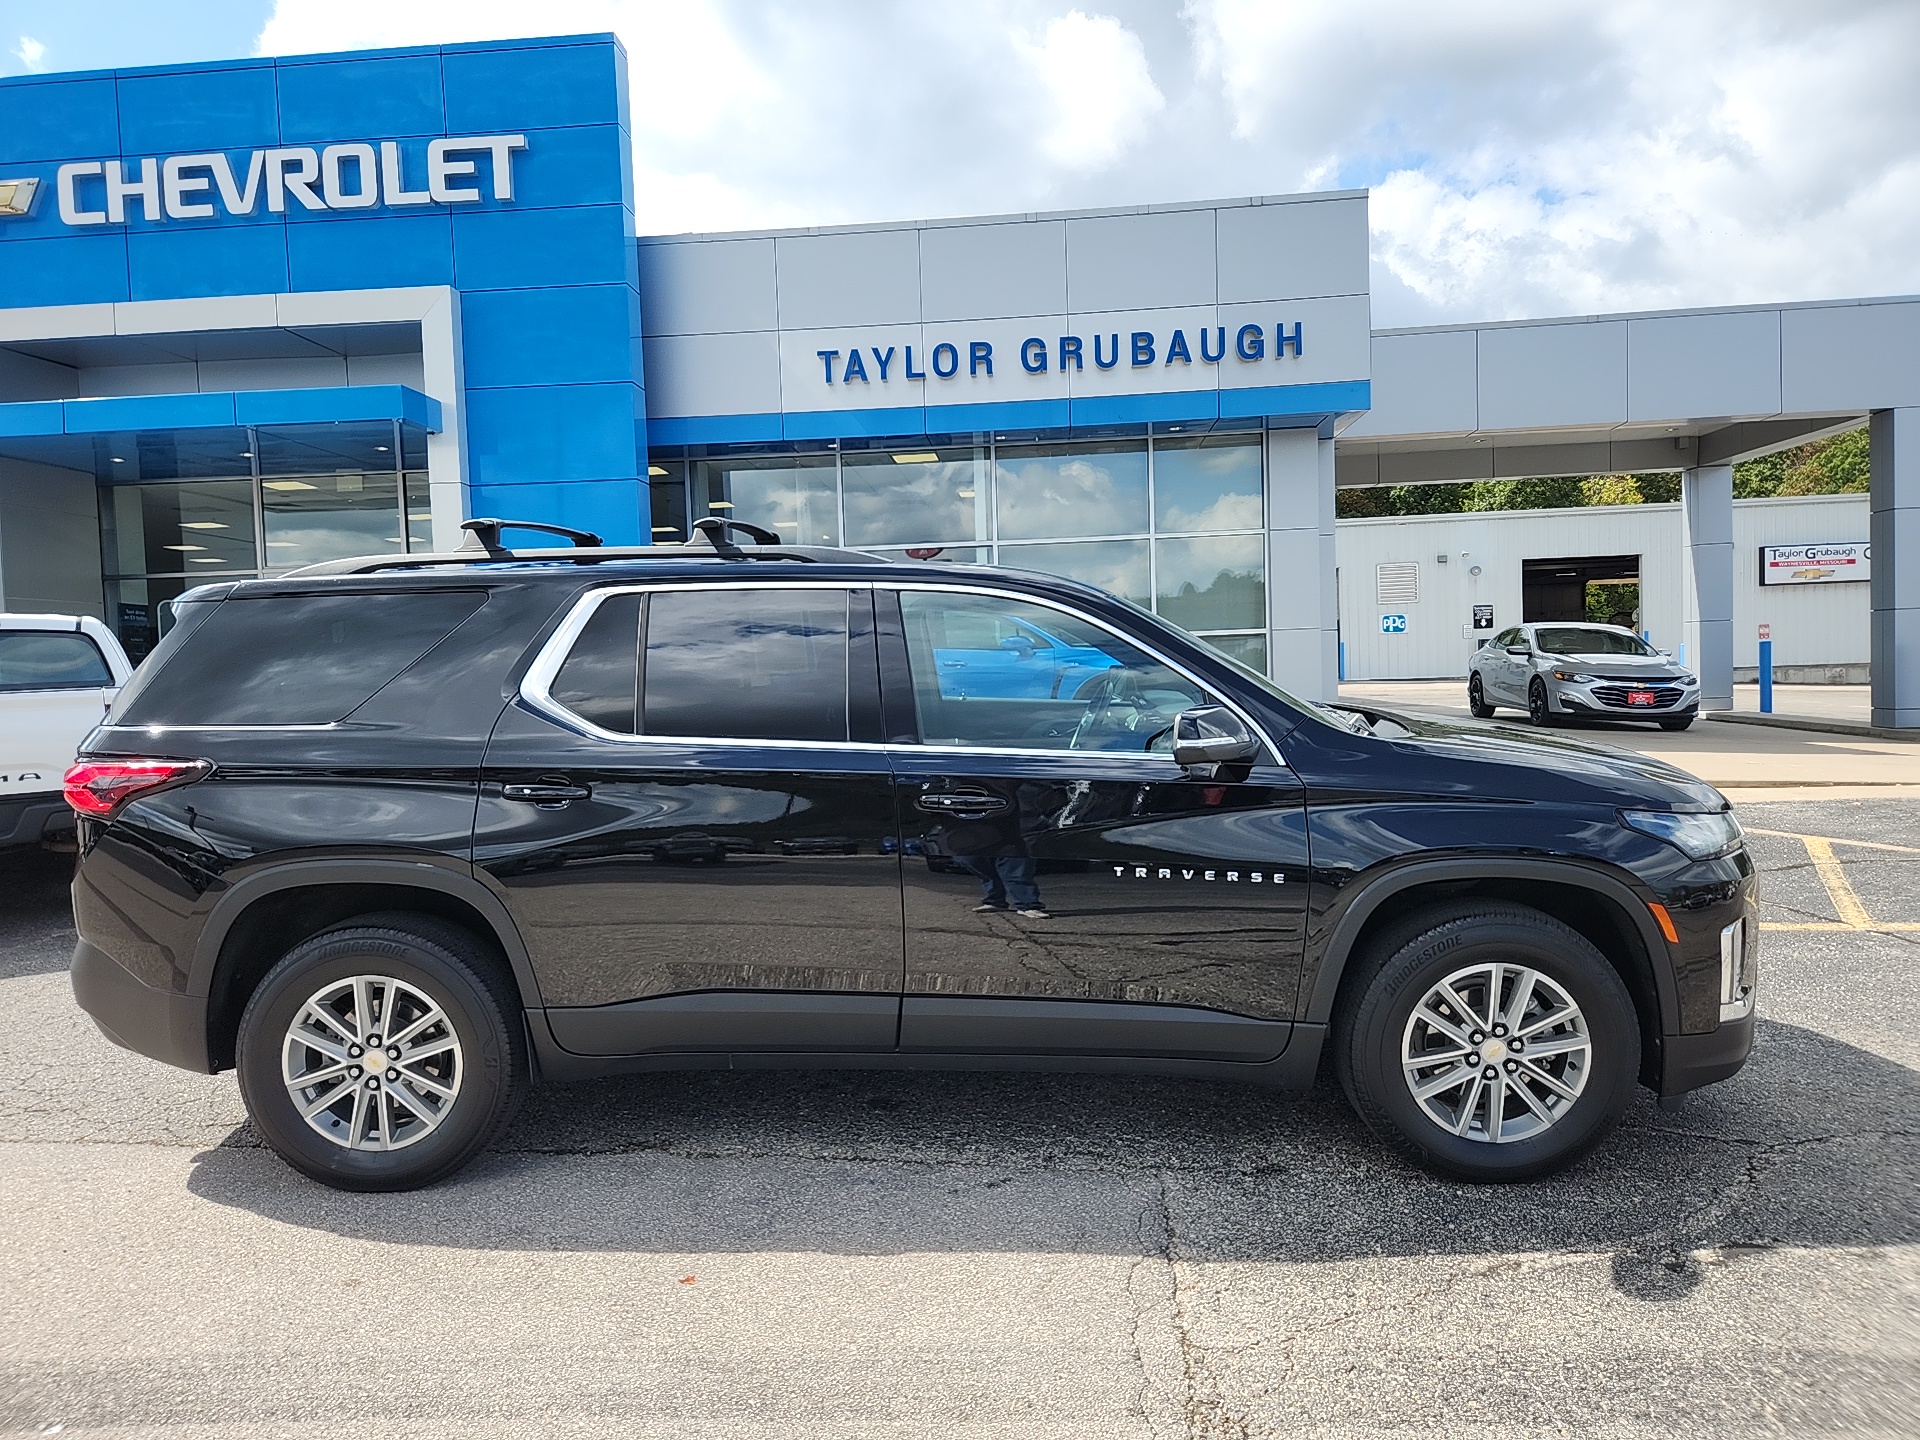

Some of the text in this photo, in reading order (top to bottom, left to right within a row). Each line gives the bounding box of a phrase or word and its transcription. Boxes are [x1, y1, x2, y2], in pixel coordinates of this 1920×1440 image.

[57, 134, 529, 226] CHEVROLET
[816, 321, 1304, 385] TAYLOR GRUBAUGH
[1769, 548, 1803, 561] Taylor
[1804, 546, 1857, 560] Grubaugh
[1383, 616, 1406, 632] PPG
[1113, 866, 1285, 884] TRAVERSE
[317, 940, 411, 959] BRIDGESTONE
[1384, 933, 1463, 998] BRIDGESTONE
